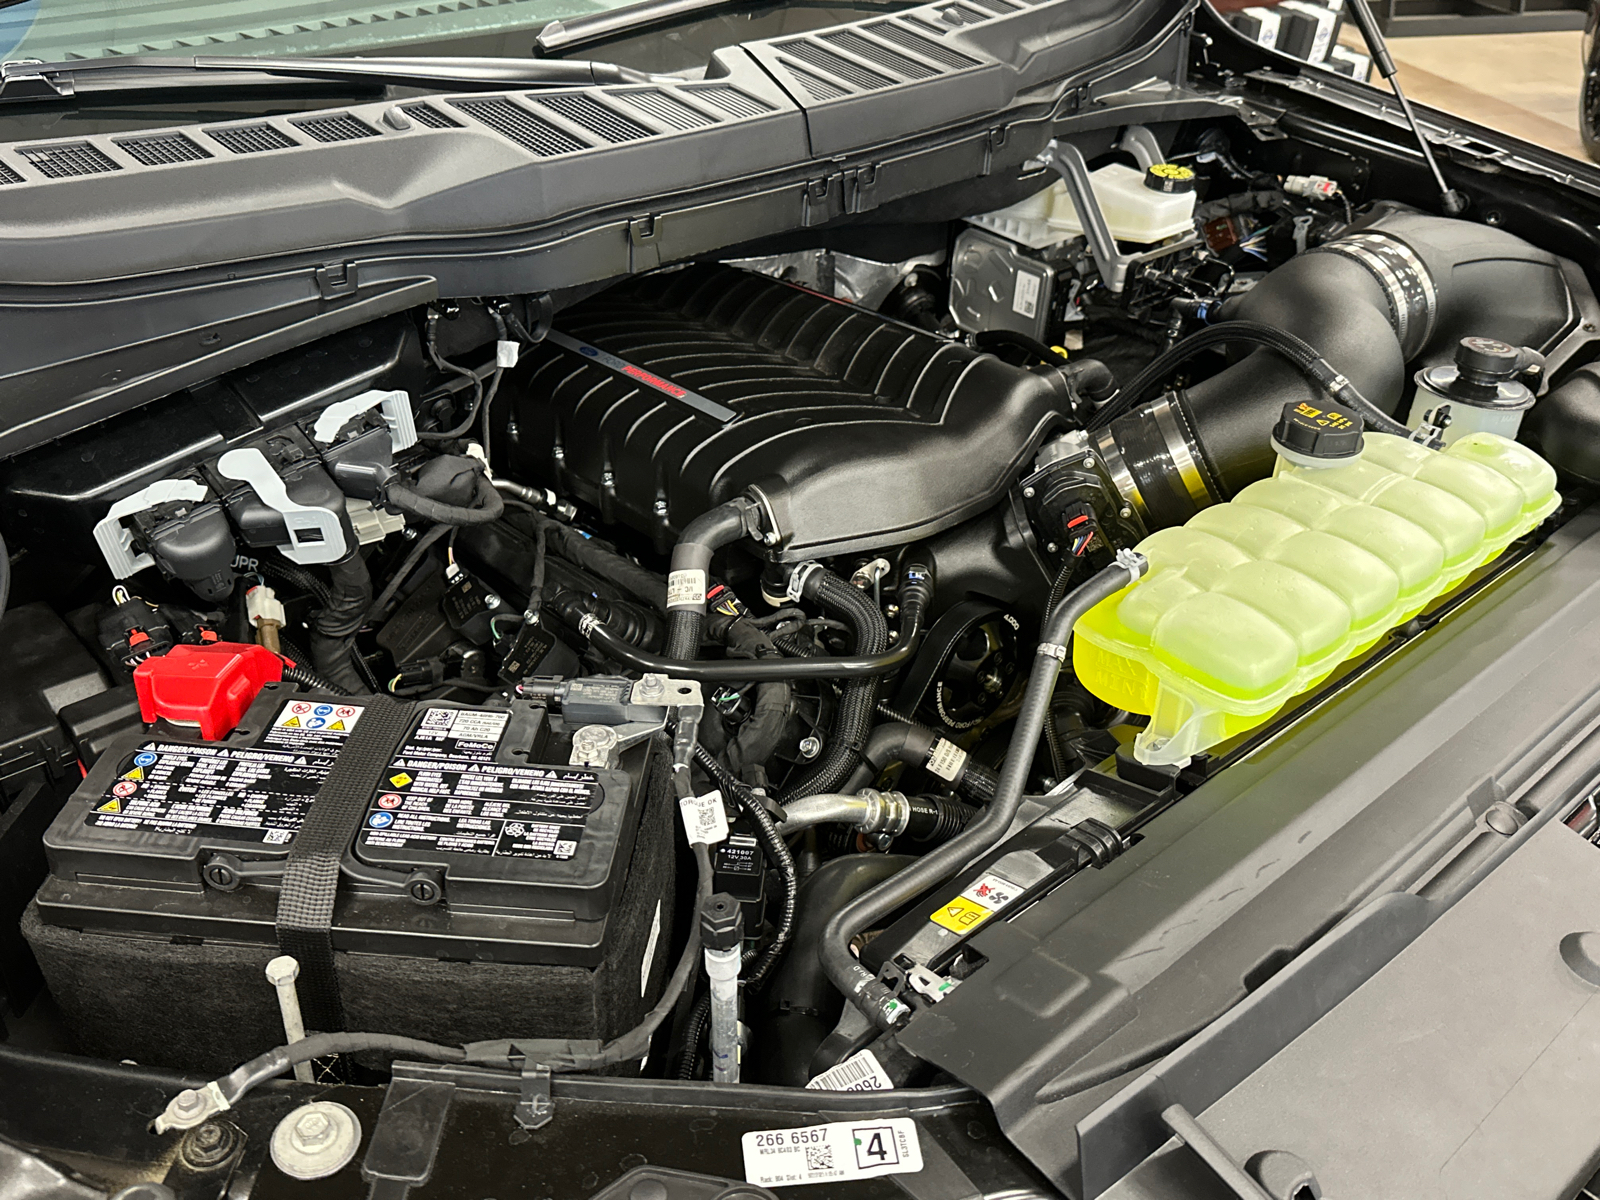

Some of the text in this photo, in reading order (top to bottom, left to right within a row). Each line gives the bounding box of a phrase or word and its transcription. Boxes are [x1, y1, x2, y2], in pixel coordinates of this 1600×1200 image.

[621, 365, 686, 398] PERFORMANCE
[1095, 671, 1137, 696] MIN
[157, 744, 218, 756] DANGER/POISON
[457, 741, 493, 750] FoMoCo
[230, 750, 295, 763] PELIGRO/VENENO
[407, 760, 467, 771] DANGER/POISON
[481, 765, 545, 778] PELIGRO/VENENO
[708, 797, 718, 805] OK
[912, 806, 928, 814] HOSE
[756, 1128, 888, 1161] 266 6567 4
